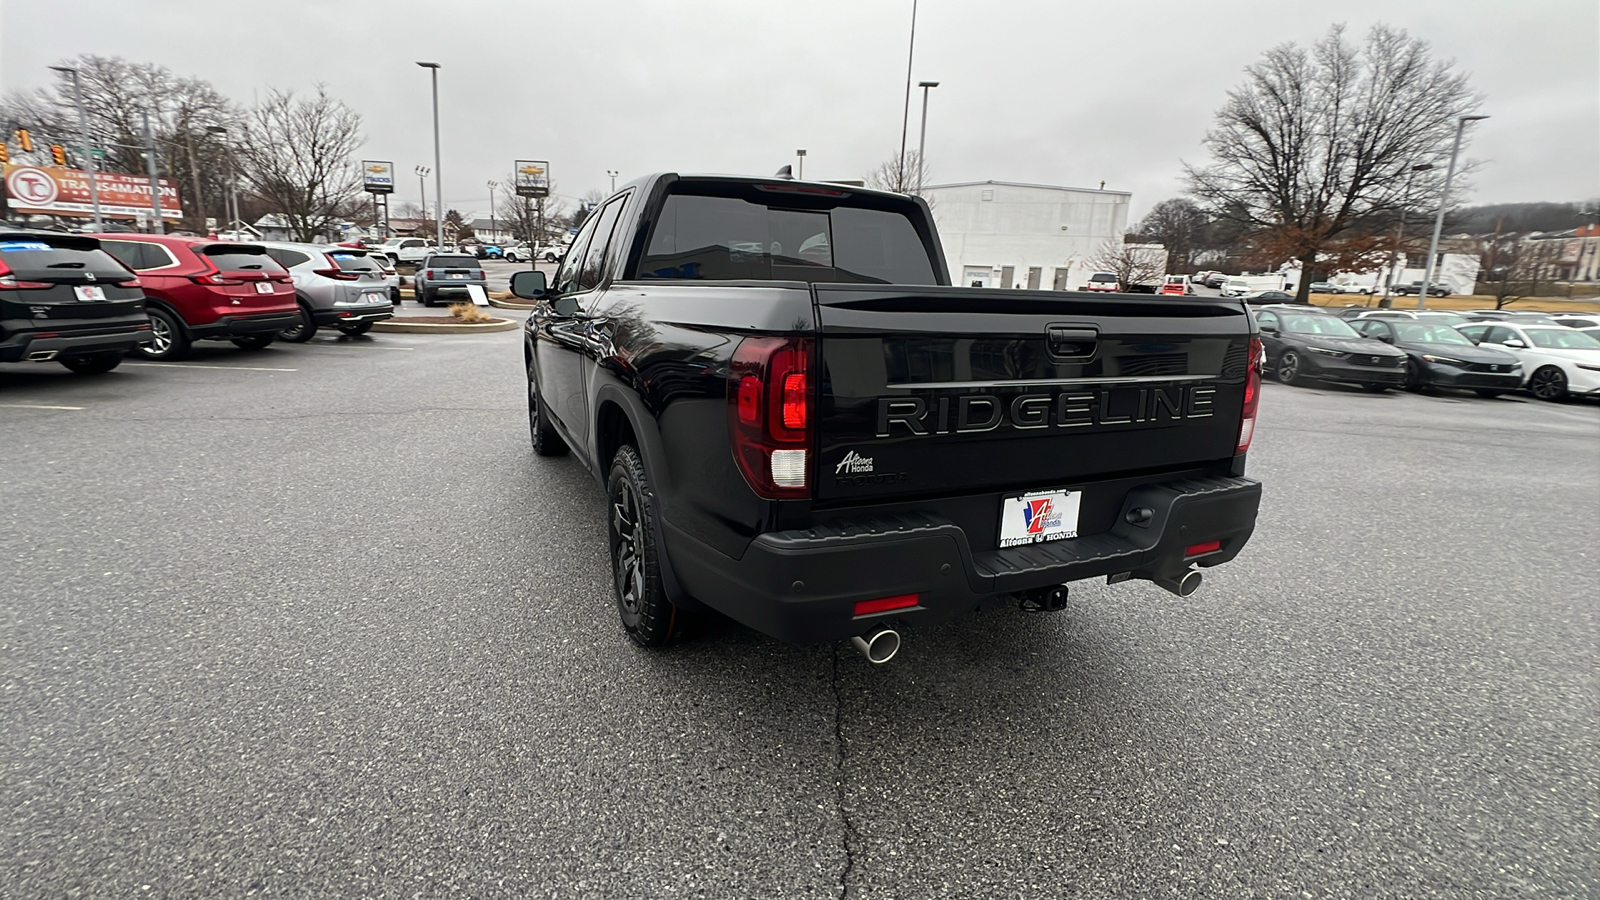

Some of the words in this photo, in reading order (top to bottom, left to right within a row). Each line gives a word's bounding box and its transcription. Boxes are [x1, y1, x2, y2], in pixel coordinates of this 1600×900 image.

[875, 386, 1217, 437] RIDGELINE
[851, 465, 873, 473] Honda
[835, 472, 907, 487] HONDA
[1000, 537, 1033, 548] Altoona
[1046, 531, 1078, 541] HONDA
